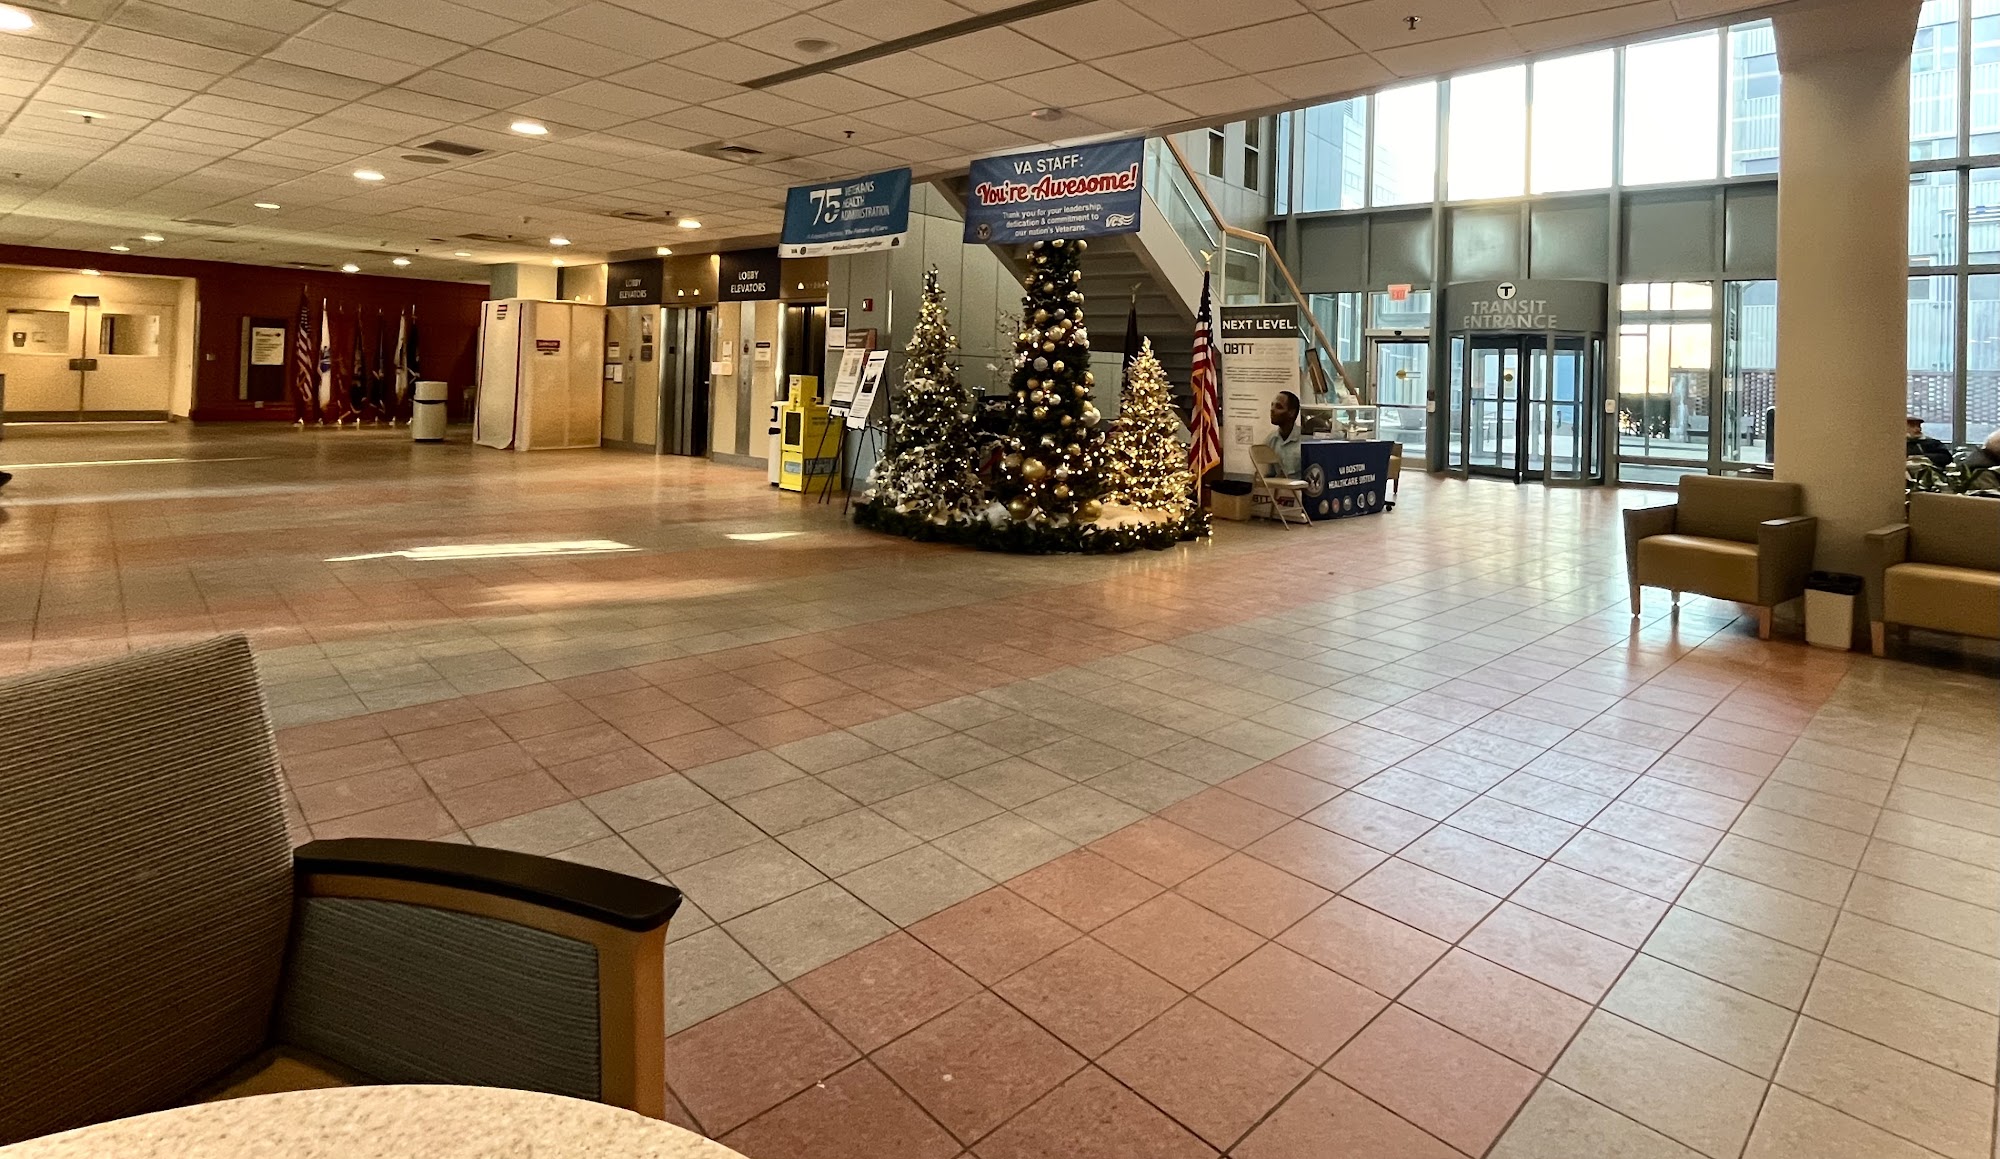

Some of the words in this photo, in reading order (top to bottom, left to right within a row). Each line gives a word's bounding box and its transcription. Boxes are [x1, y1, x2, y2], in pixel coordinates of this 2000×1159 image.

[1013, 160, 1033, 175] VA
[1036, 153, 1084, 173] STAFF:
[844, 181, 875, 197] VETERANS
[975, 179, 1029, 206] You're
[1030, 161, 1139, 201] Awesome!
[809, 187, 843, 226] 75
[842, 195, 865, 209] HEALTH
[840, 204, 890, 221] ADMINISTRATION
[1002, 210, 1020, 220] Thank
[1021, 210, 1036, 220] you
[1036, 208, 1046, 217] for
[1047, 207, 1062, 217] your
[1063, 202, 1104, 214] leadership,
[1006, 218, 1040, 229] dedication
[1040, 217, 1046, 226] &
[1047, 213, 1090, 225] commitment
[1090, 213, 1099, 221] to
[1014, 229, 1028, 237] our
[1028, 226, 1054, 236] nation's
[625, 278, 642, 288] LOBBY
[738, 270, 760, 281] LOBBY
[619, 289, 647, 299] ELEVATORS
[730, 282, 766, 294] ELEVATORS
[1500, 285, 1513, 296] T
[1471, 299, 1547, 315] TRANSIT
[1222, 319, 1253, 330] NEXT
[1256, 319, 1297, 330] LEVEL.
[1463, 314, 1558, 329] ENTRANCE
[1345, 463, 1366, 474] BOSTON
[1328, 476, 1359, 489] HEALTHCARE
[1358, 473, 1376, 485] SYSTEM
